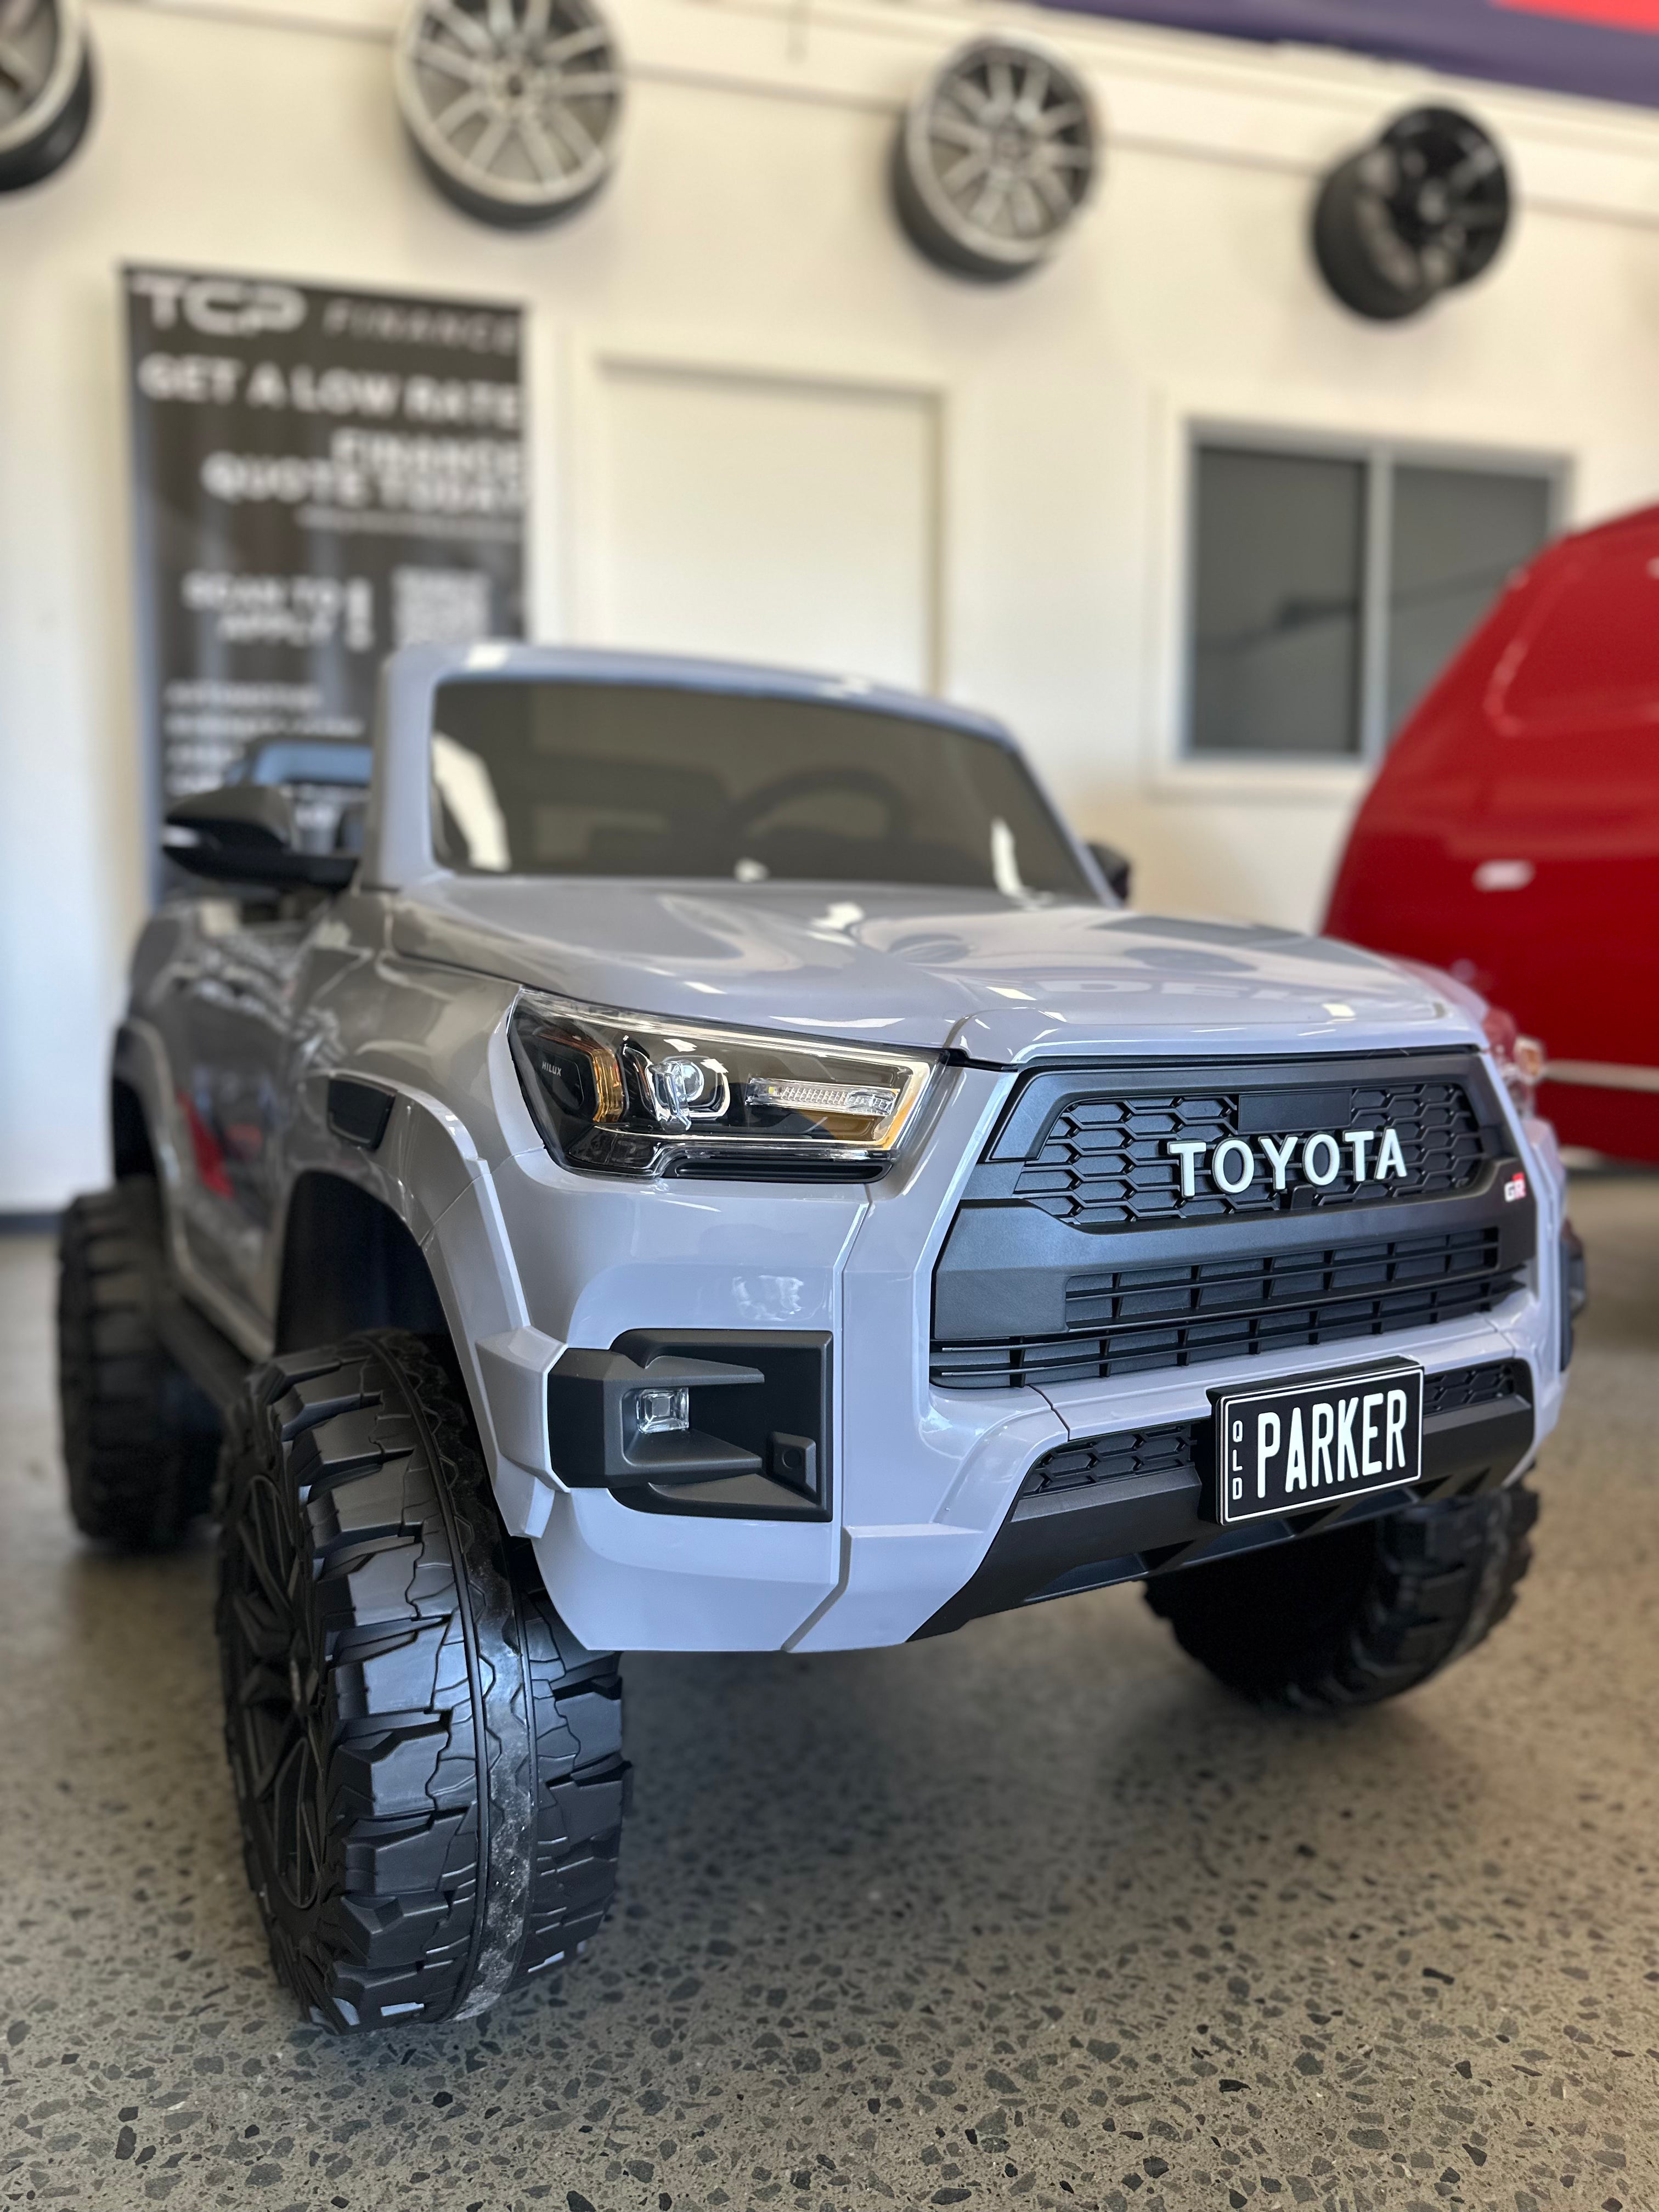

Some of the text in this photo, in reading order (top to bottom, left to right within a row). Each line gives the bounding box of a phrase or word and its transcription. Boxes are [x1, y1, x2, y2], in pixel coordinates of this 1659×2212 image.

[131, 274, 308, 337] TCP
[137, 352, 241, 403] GET
[247, 361, 288, 409] A
[290, 363, 401, 419] LOW
[541, 1060, 562, 1076] HILUX
[1168, 1127, 1408, 1198] TOYOTA
[1504, 1179, 1527, 1203] GR
[1232, 1420, 1243, 1500] QLD
[1257, 1389, 1408, 1499] PARKER
